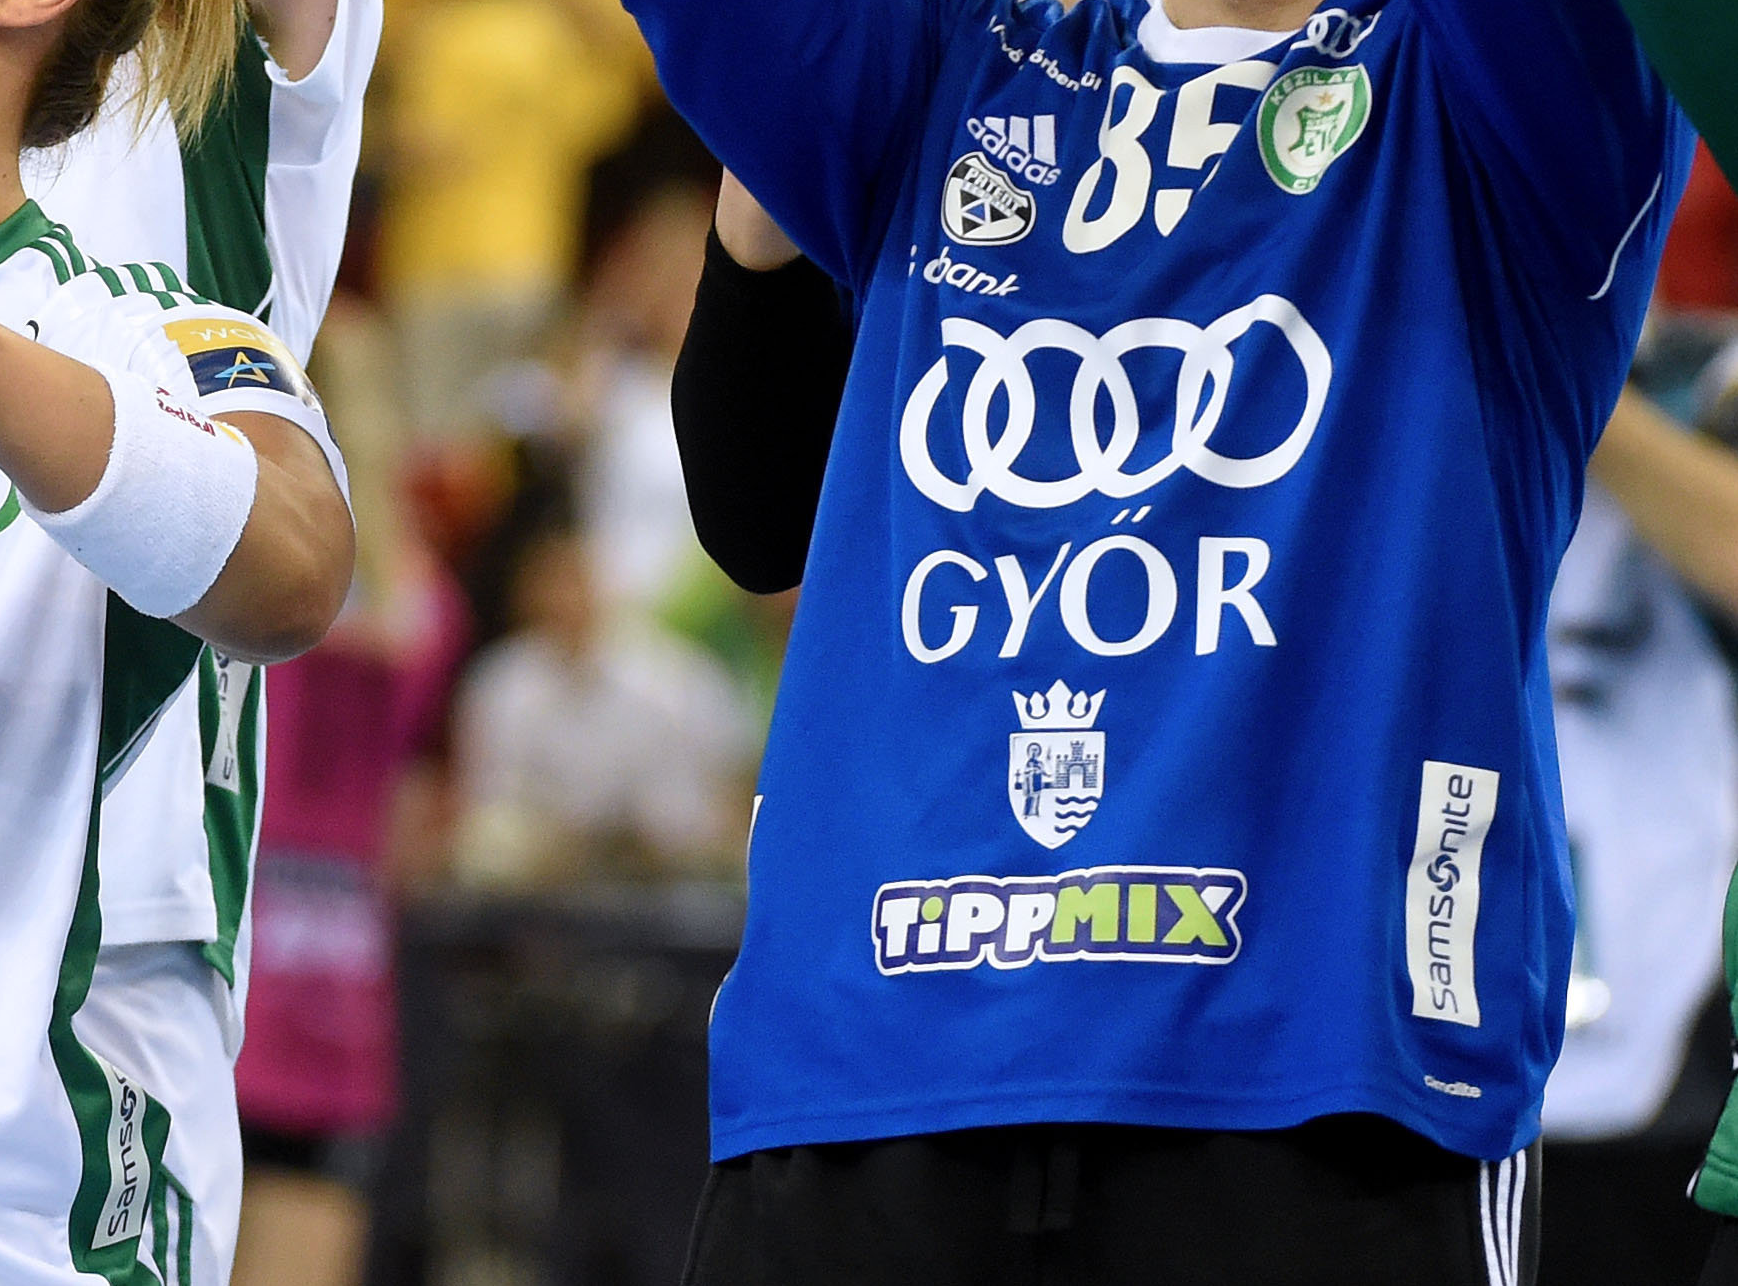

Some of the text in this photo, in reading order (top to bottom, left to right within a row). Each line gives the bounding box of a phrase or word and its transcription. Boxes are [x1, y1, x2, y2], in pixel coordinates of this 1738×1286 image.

[967, 118, 1061, 186] adidas
[901, 506, 1278, 664] GYŐR
[878, 883, 1237, 957] TiPPMIX
